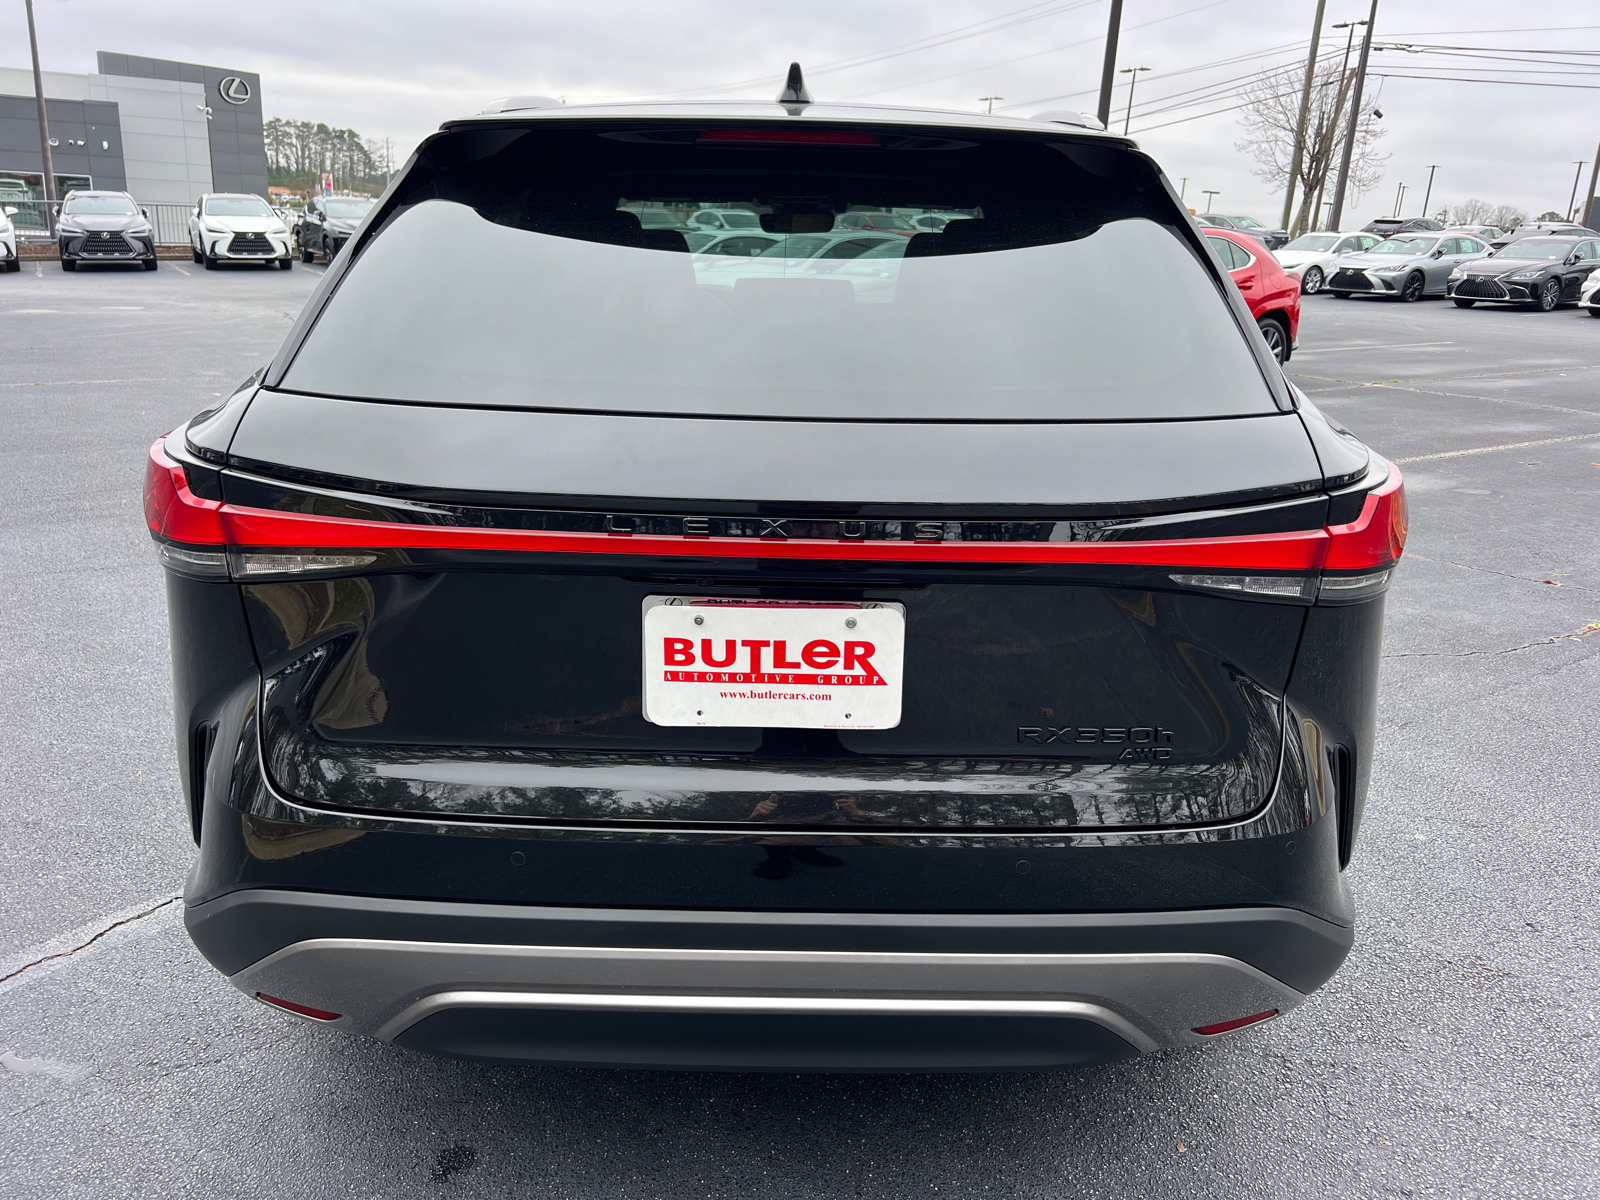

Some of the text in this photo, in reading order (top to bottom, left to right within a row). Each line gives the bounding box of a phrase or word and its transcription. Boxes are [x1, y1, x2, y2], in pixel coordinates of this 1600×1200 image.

[606, 514, 944, 542] LEXUS
[664, 671, 880, 686] AUTOMOTIVE GROUP
[719, 689, 833, 702] www.butlercars.com
[1016, 726, 1175, 744] RX350h
[1117, 747, 1173, 761] AWD
